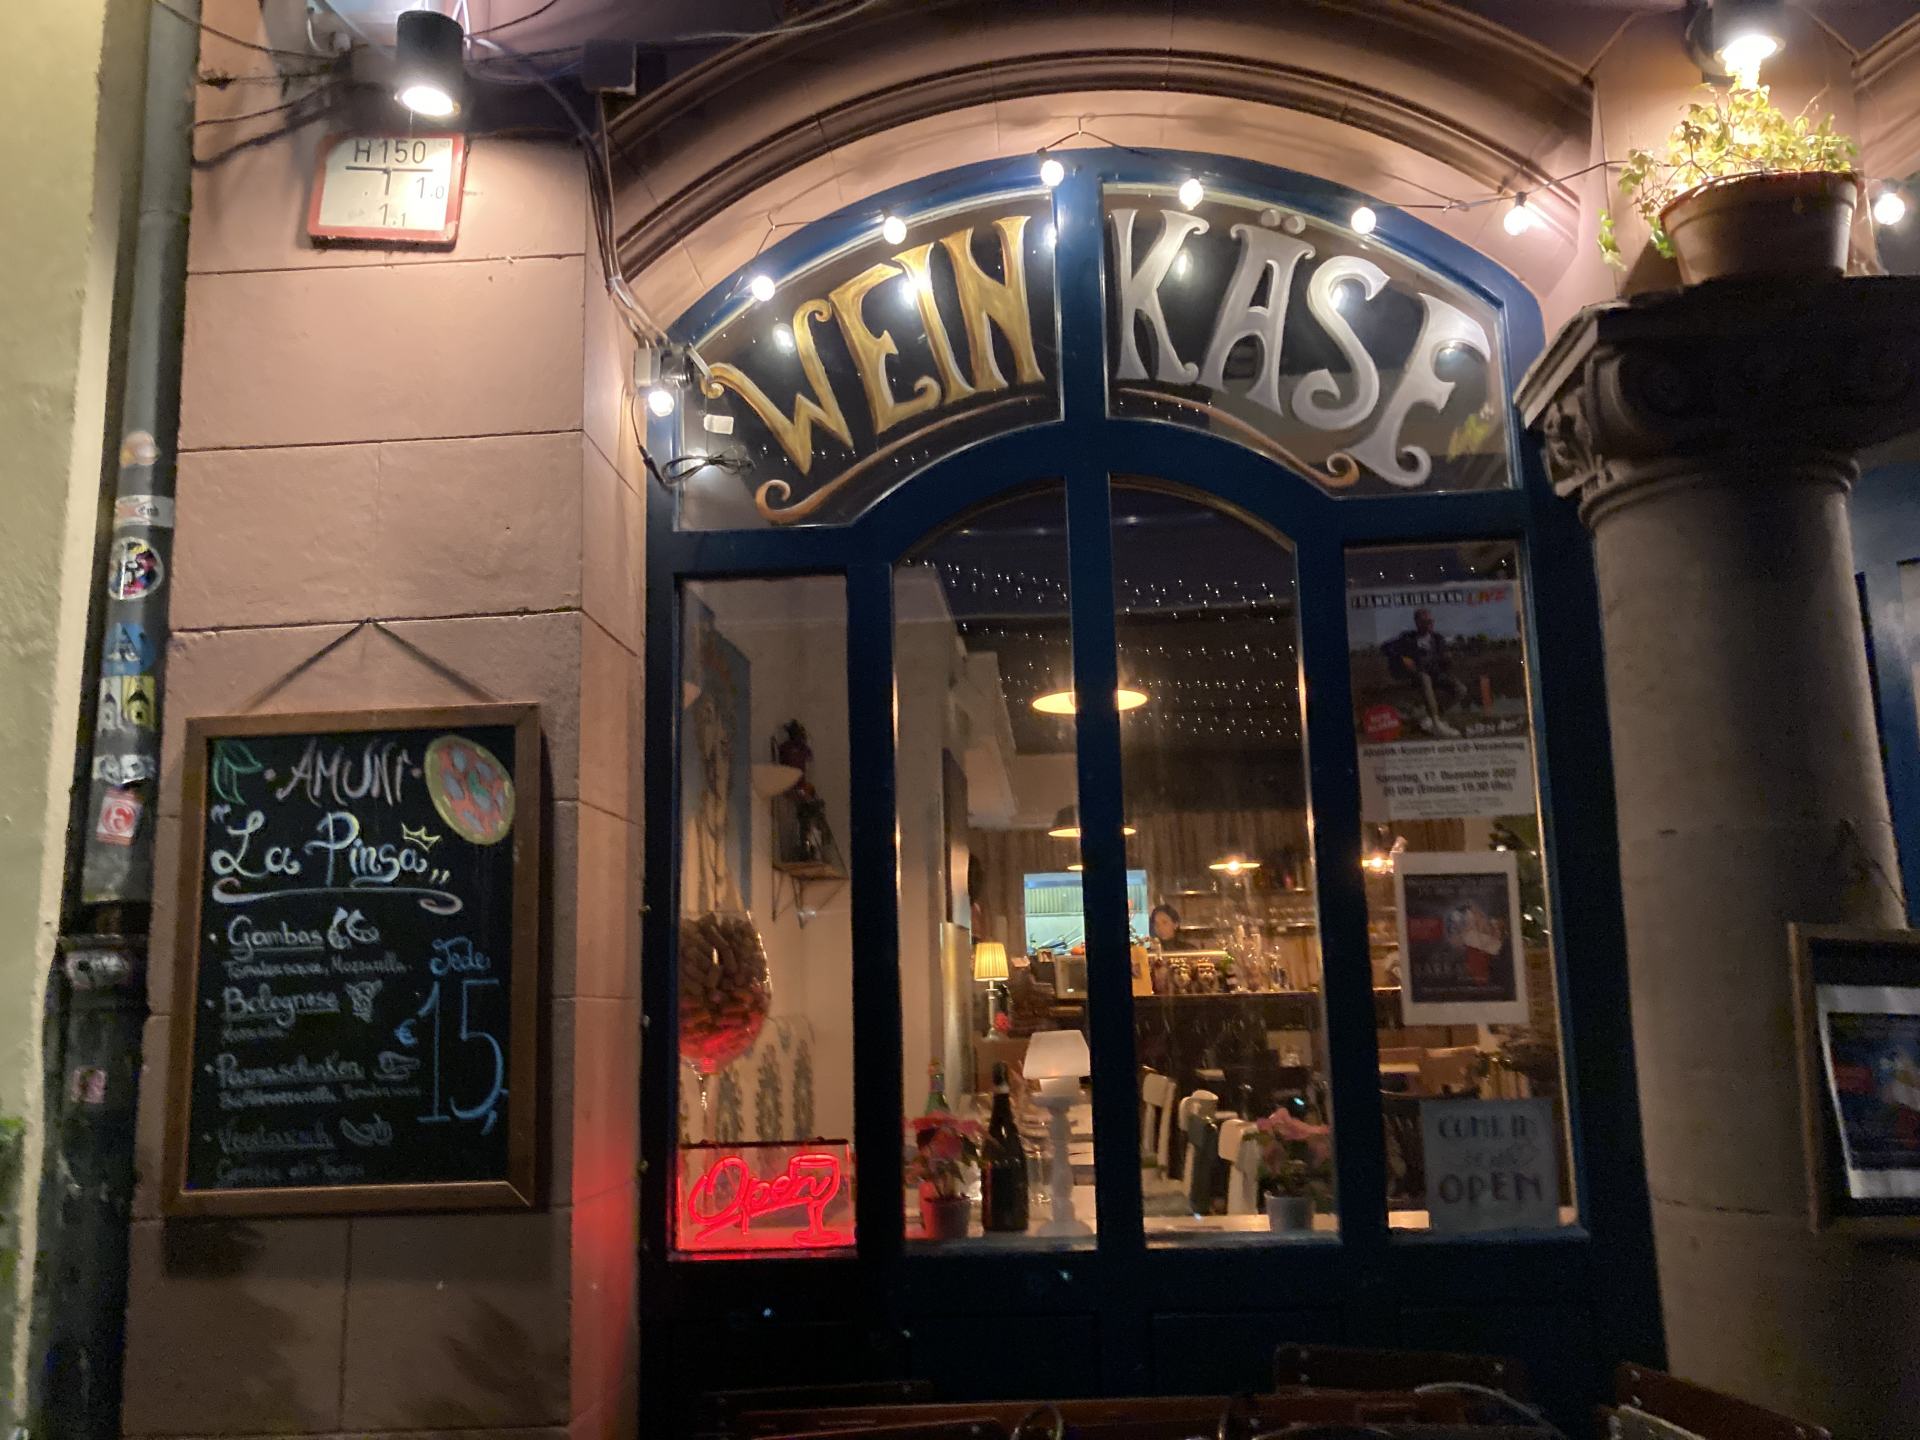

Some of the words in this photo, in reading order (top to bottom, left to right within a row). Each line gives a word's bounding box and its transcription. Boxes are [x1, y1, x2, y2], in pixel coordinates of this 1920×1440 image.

[353, 139, 427, 163] H150
[379, 203, 407, 226] 1.1
[700, 214, 1044, 475] WEIN
[1108, 207, 1493, 487] KÄSE
[228, 914, 325, 962] Gambas
[222, 981, 341, 1028] Bolognese
[688, 1156, 832, 1237] Open
[1438, 1171, 1544, 1204] OPEN
